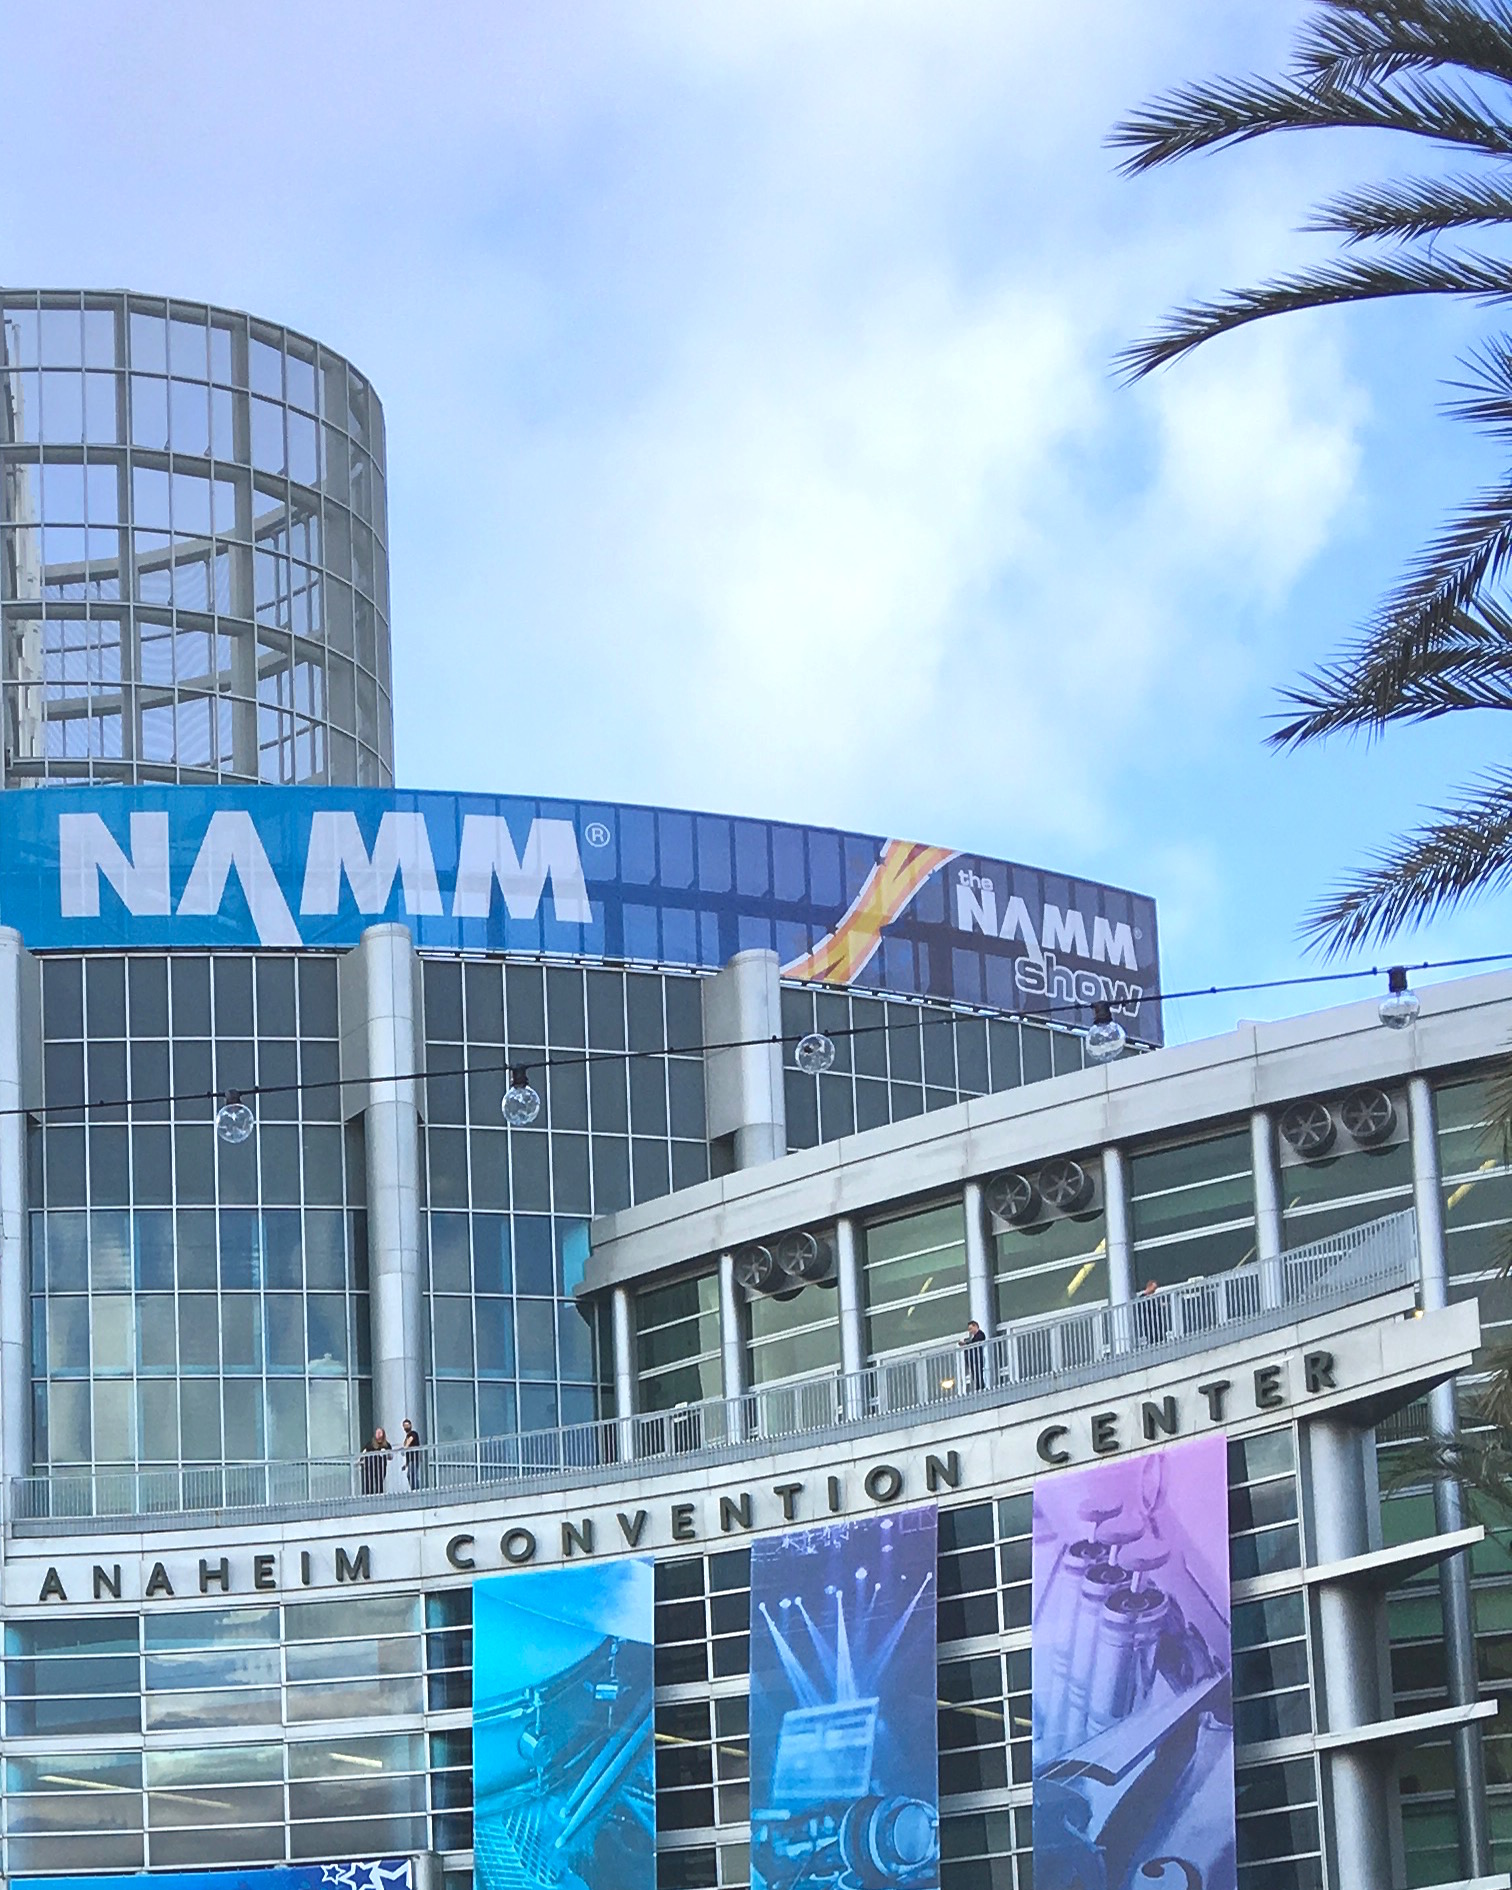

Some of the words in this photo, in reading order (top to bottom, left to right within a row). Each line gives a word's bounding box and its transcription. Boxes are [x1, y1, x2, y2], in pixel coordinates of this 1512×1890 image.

[59, 810, 592, 947] NAMM
[958, 869, 994, 890] the
[956, 884, 1138, 971] NAMM
[1014, 952, 1143, 1018] show
[40, 1543, 372, 1603] ANAHEIM
[446, 1450, 960, 1569] CONVENTION
[1036, 1349, 1337, 1465] CENTER
